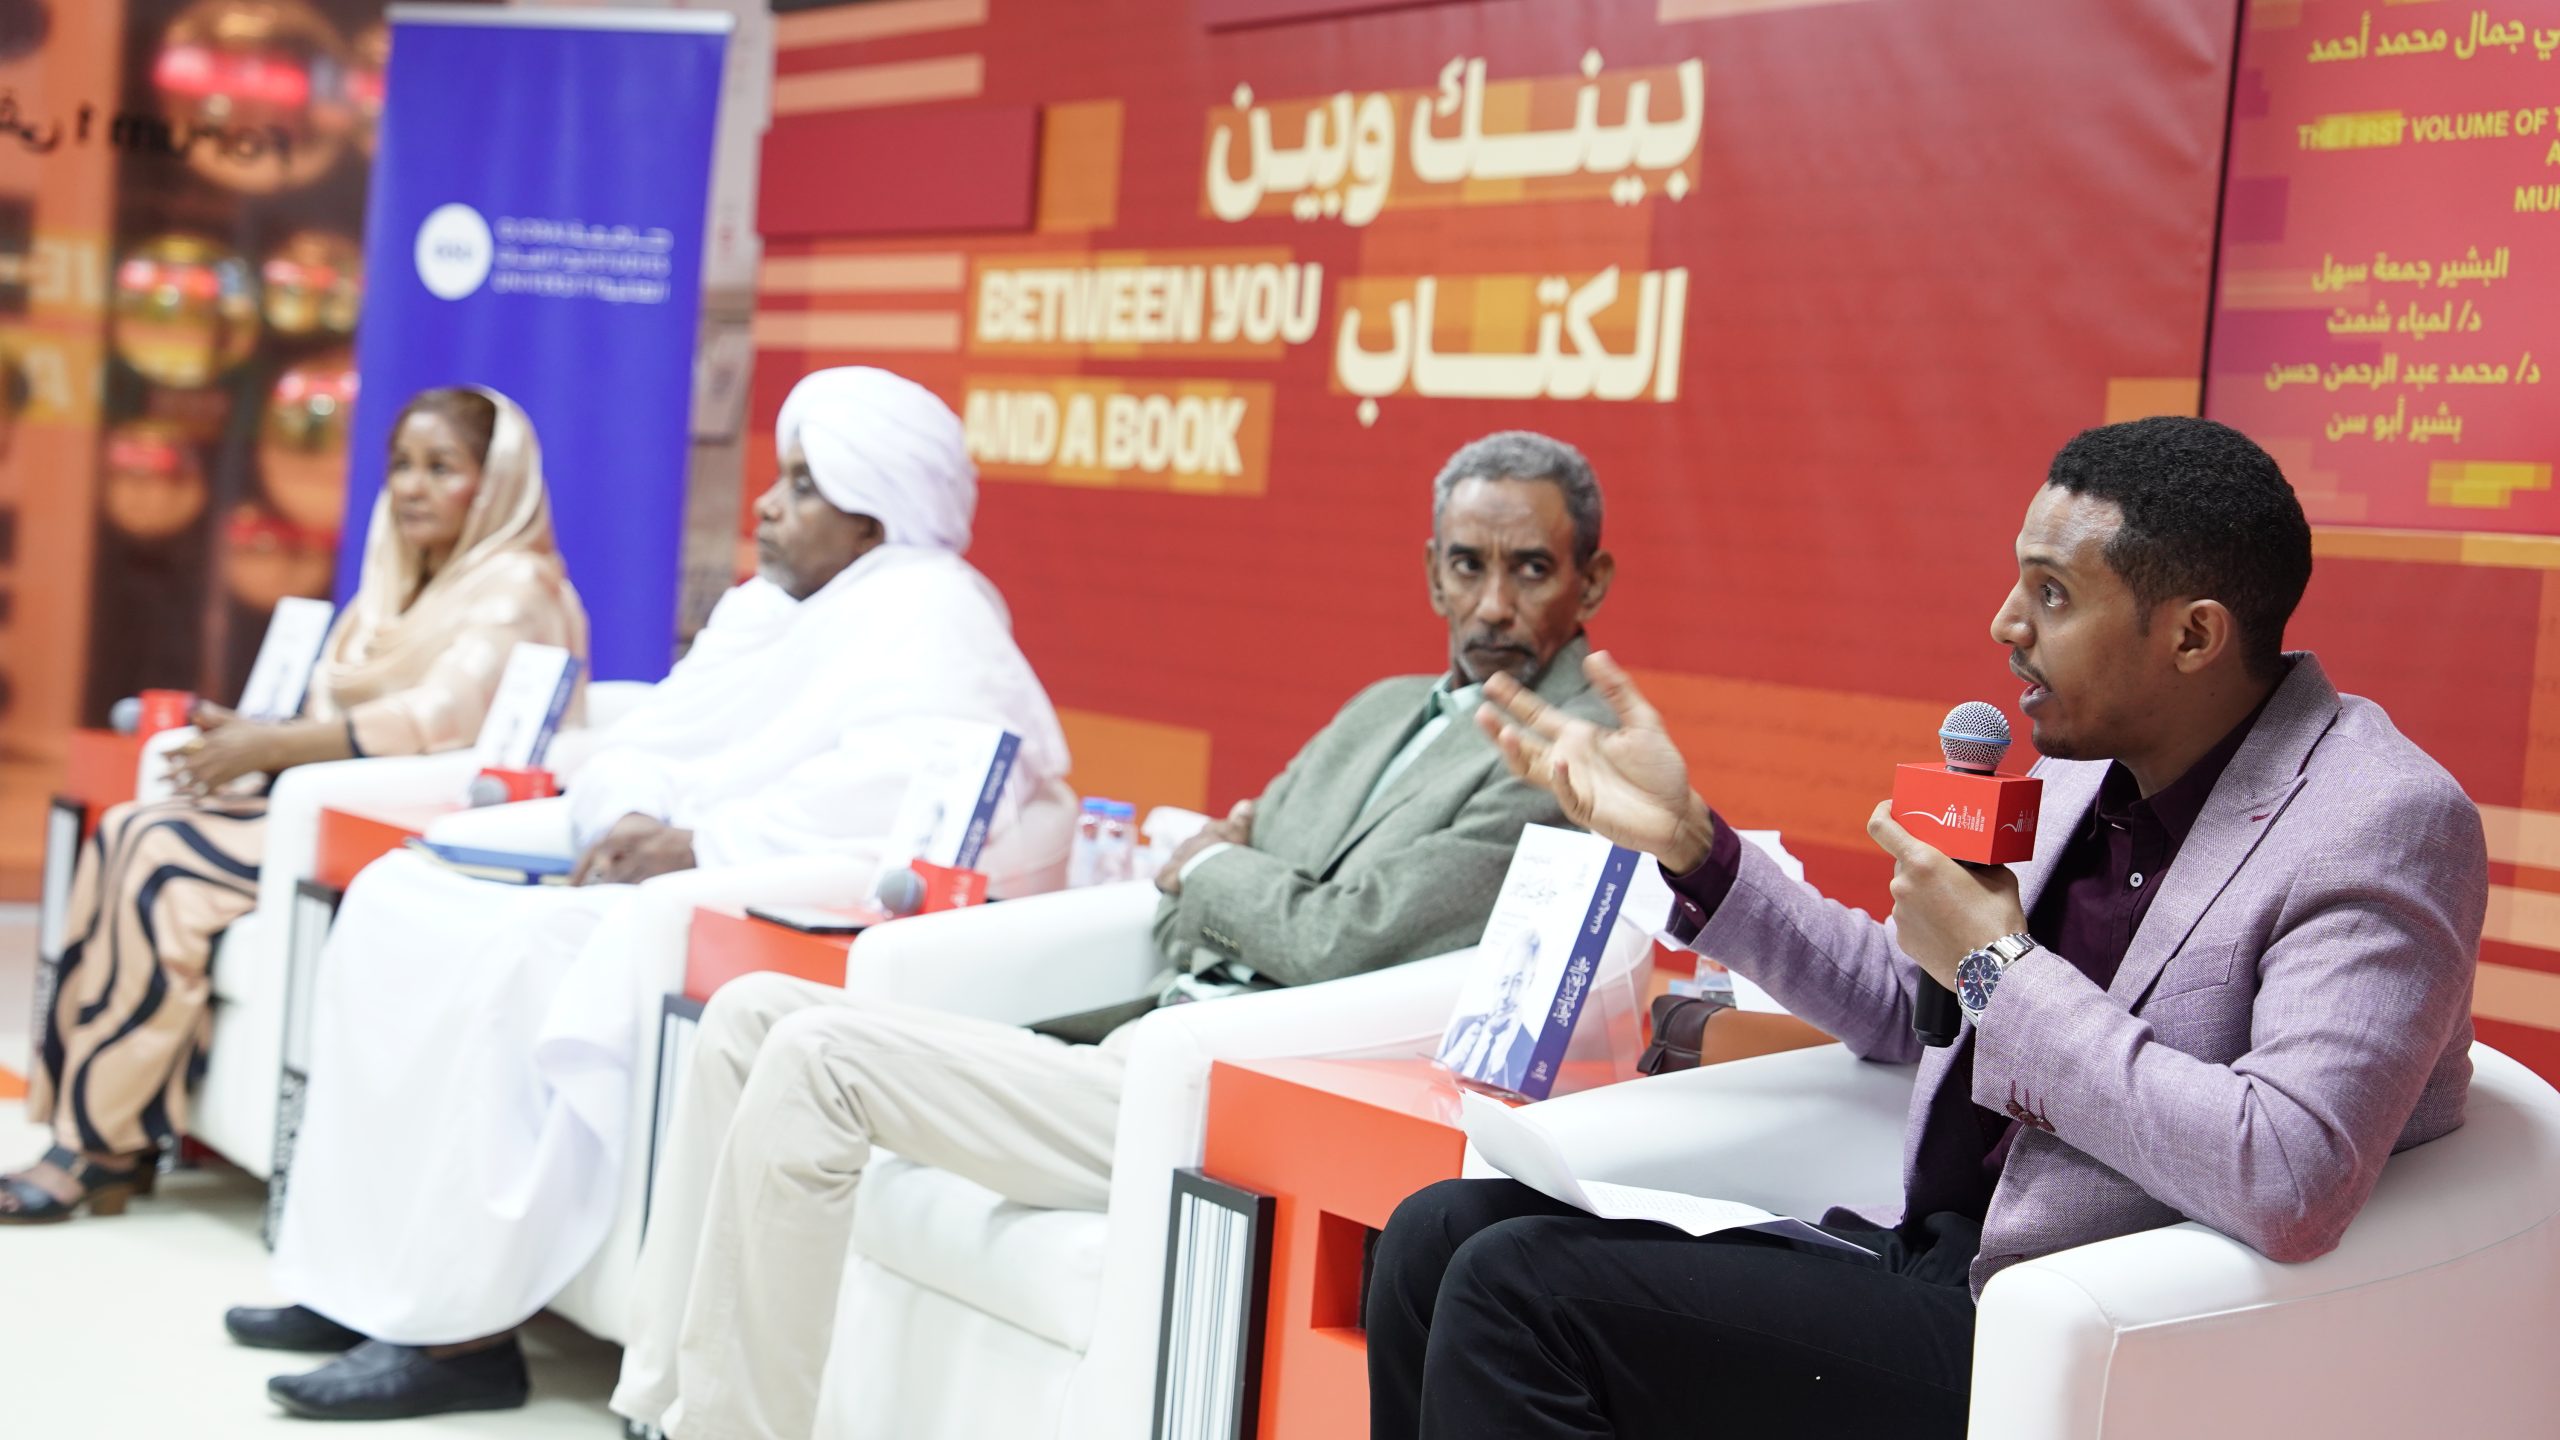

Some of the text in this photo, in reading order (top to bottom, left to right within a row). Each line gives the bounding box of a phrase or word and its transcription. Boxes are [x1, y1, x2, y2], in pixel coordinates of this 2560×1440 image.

[2307, 10, 2370, 63] أحمد
[2375, 28, 2447, 57] محمد
[2454, 10, 2525, 60] جمال
[2412, 110, 2509, 143] VOLUME
[2515, 107, 2549, 136] OF
[1206, 81, 1396, 227] وبين
[2312, 246, 2510, 292] البشير جمعة سهل
[976, 262, 1324, 344] BETWEEN YOU
[2327, 300, 2391, 334] شمت
[1335, 263, 1689, 428] الكتاب
[2265, 361, 2319, 392] حسن
[2324, 353, 2398, 392] الرحمن
[2403, 362, 2439, 392] عبد
[2446, 361, 2508, 385] محمد
[963, 389, 1247, 476] AND A BOOK
[2326, 394, 2462, 443] بشير أبو سن
